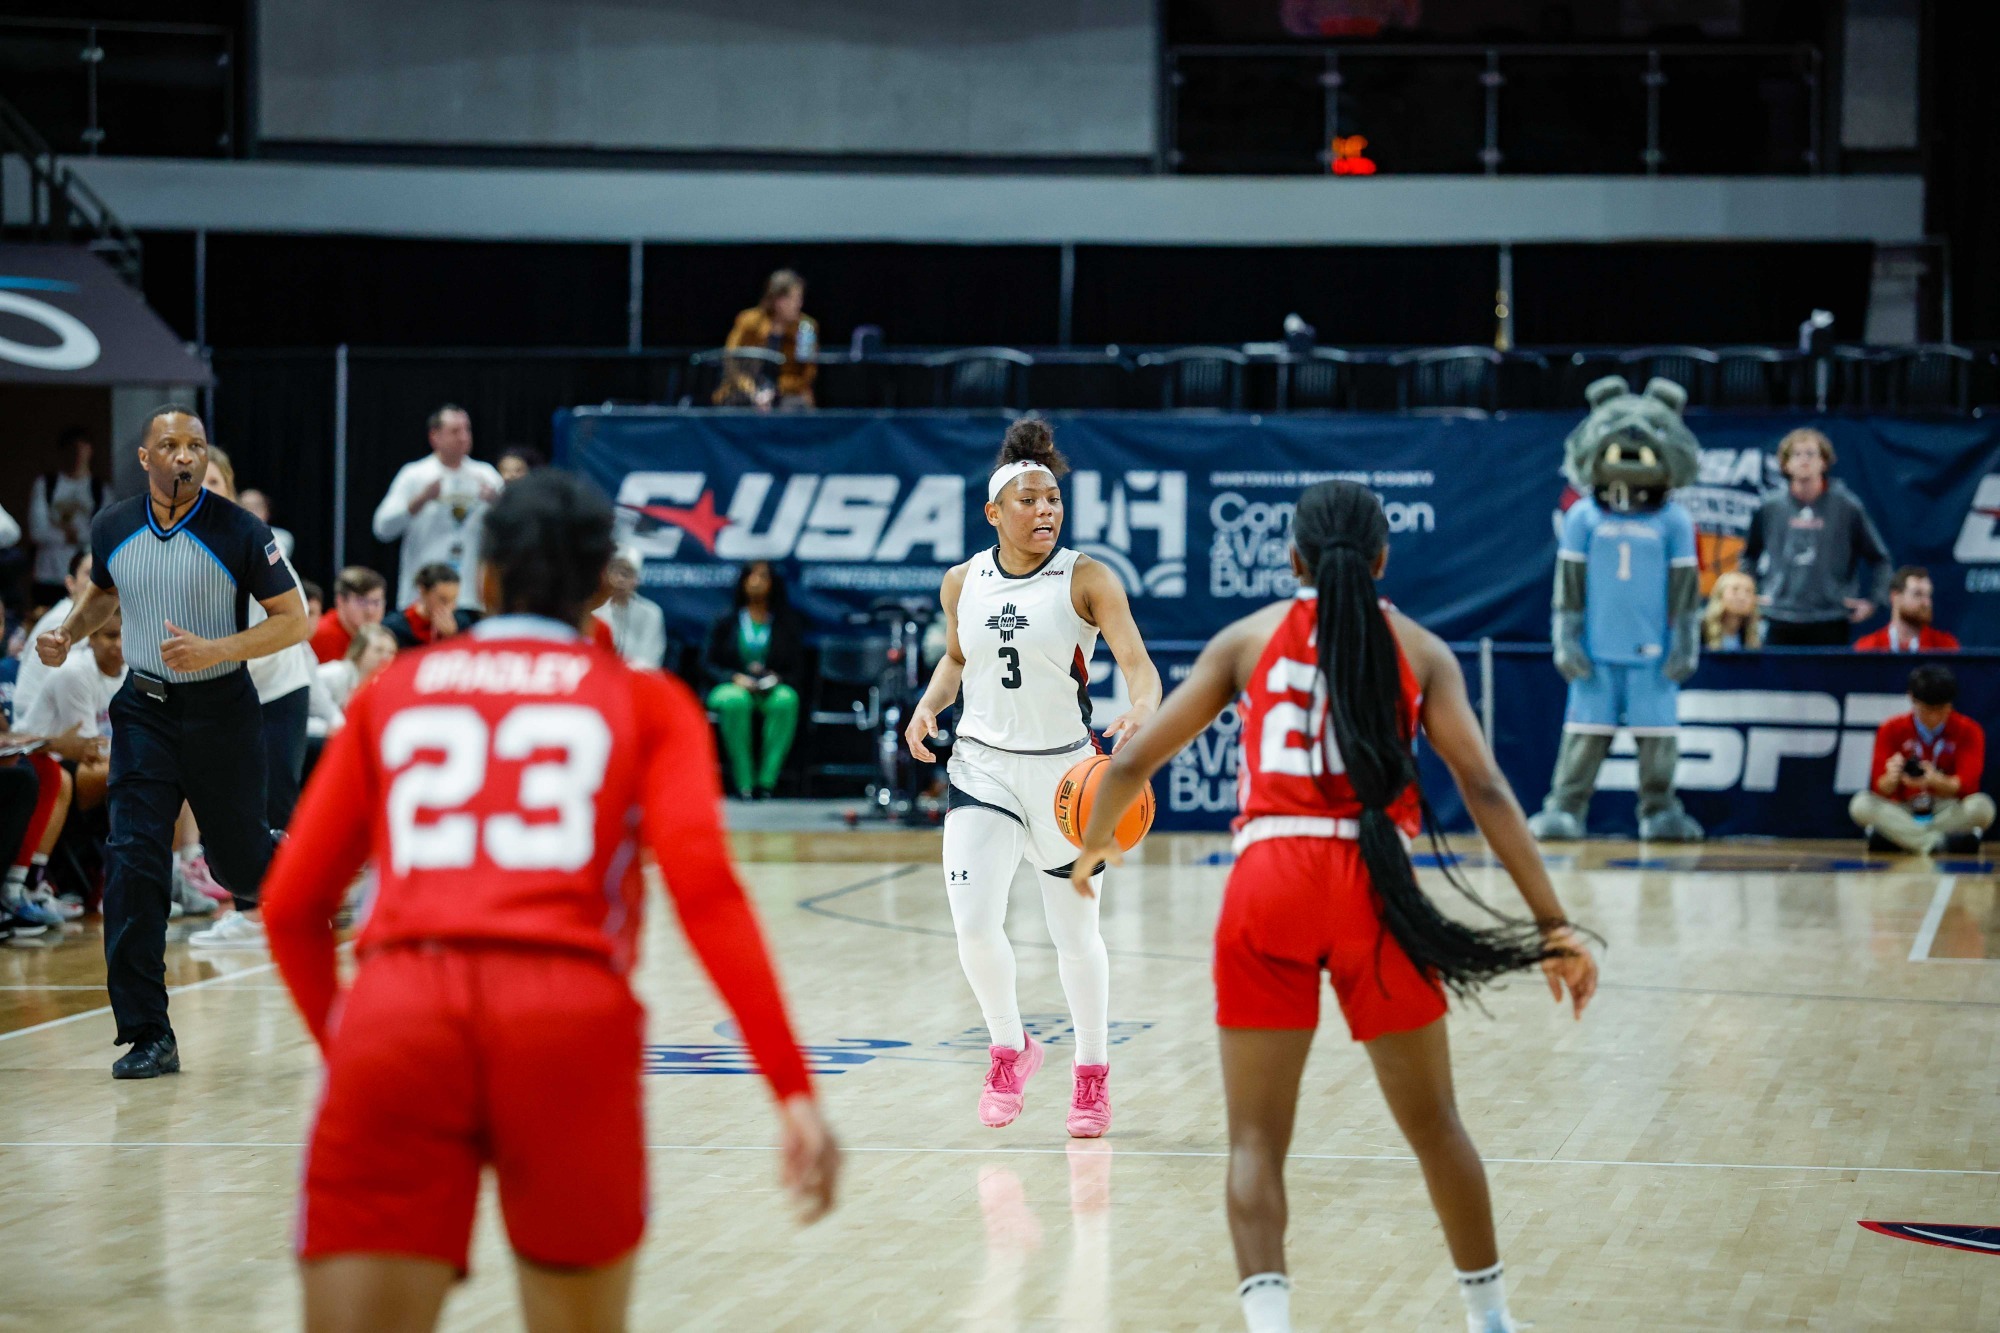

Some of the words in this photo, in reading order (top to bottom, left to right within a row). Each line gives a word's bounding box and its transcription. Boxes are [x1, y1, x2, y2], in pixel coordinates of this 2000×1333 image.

[1209, 491, 1436, 533] Conon
[1209, 558, 1301, 598] Bure
[414, 649, 592, 695] BRADLEY
[998, 647, 1022, 689] 3
[380, 702, 613, 879] 23
